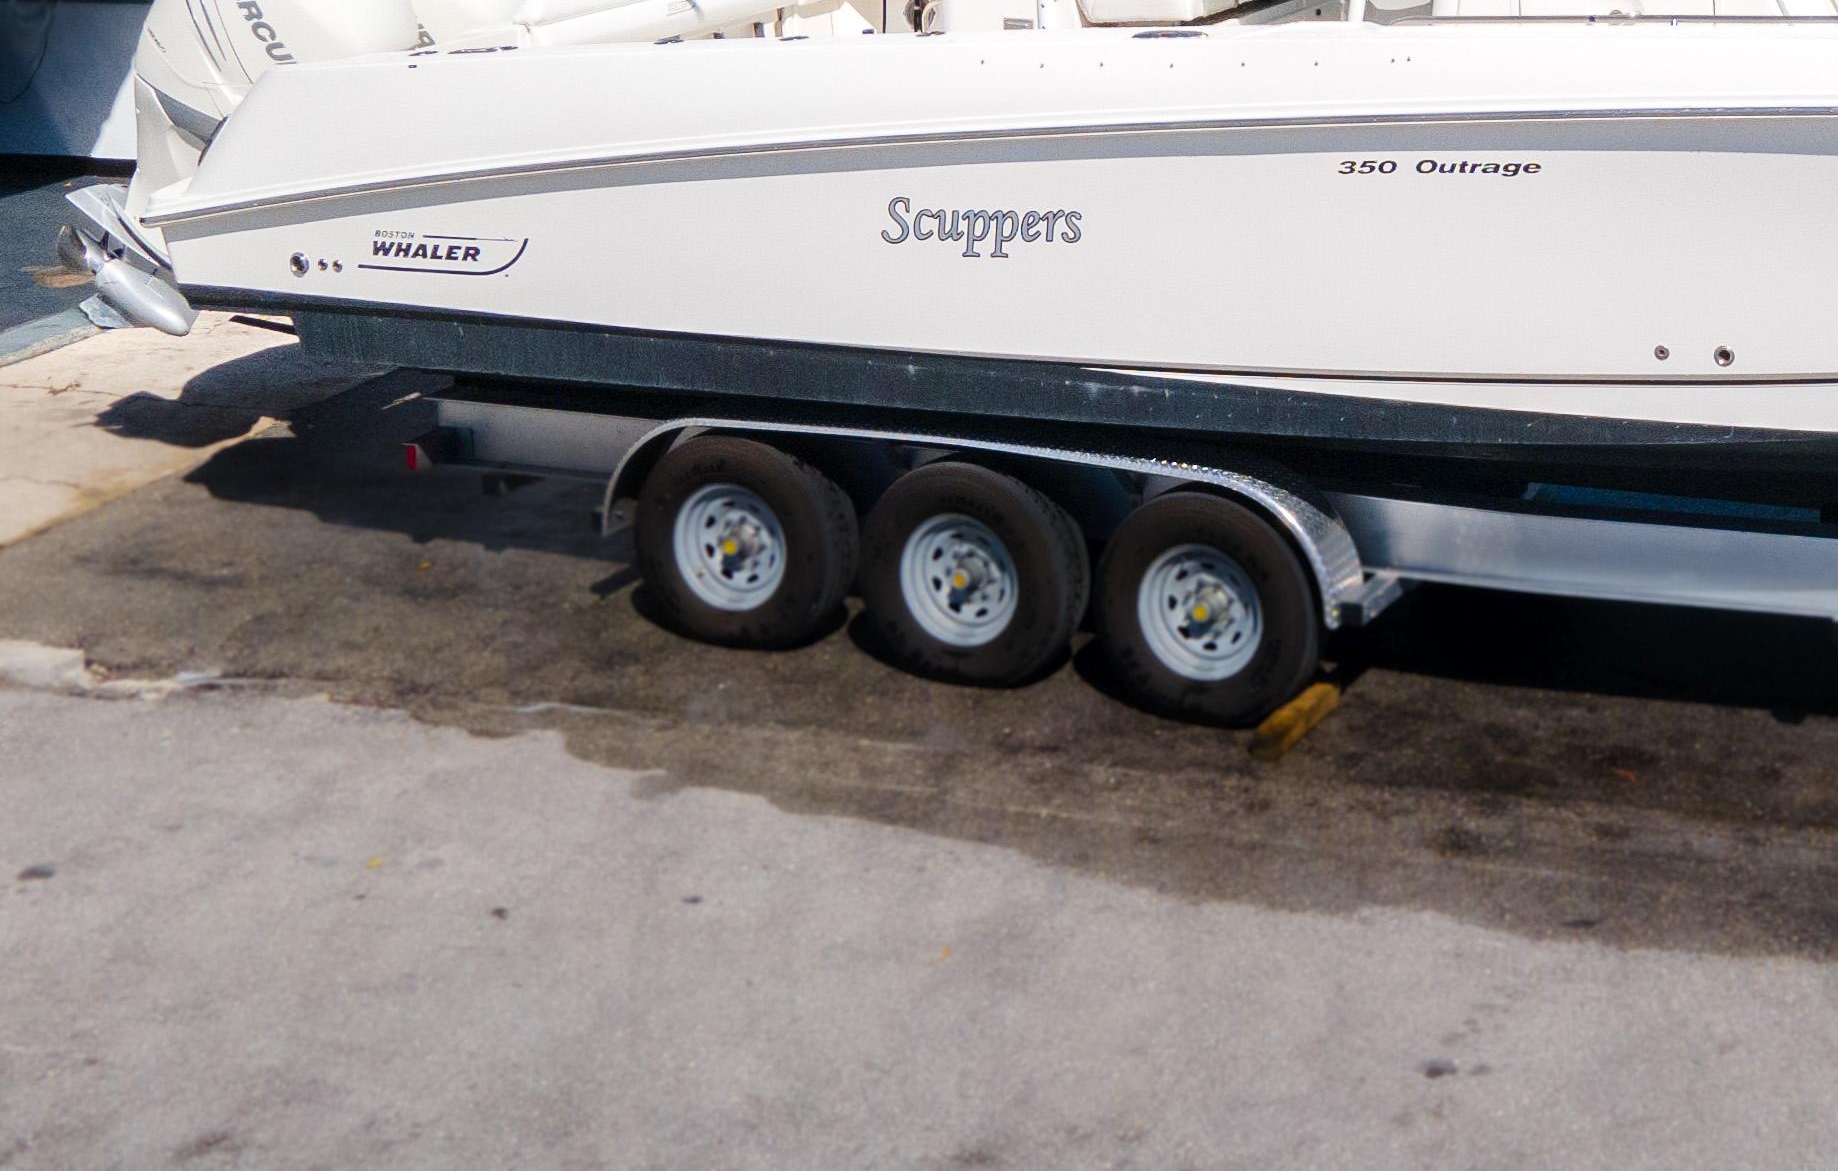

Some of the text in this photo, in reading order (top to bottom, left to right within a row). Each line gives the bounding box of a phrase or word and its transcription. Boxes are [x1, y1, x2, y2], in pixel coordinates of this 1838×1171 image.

[1337, 159, 1542, 177] 350 Outrage
[374, 229, 416, 240] BOSTON
[880, 196, 1082, 258] Scuppers
[372, 240, 482, 262] WHALER
